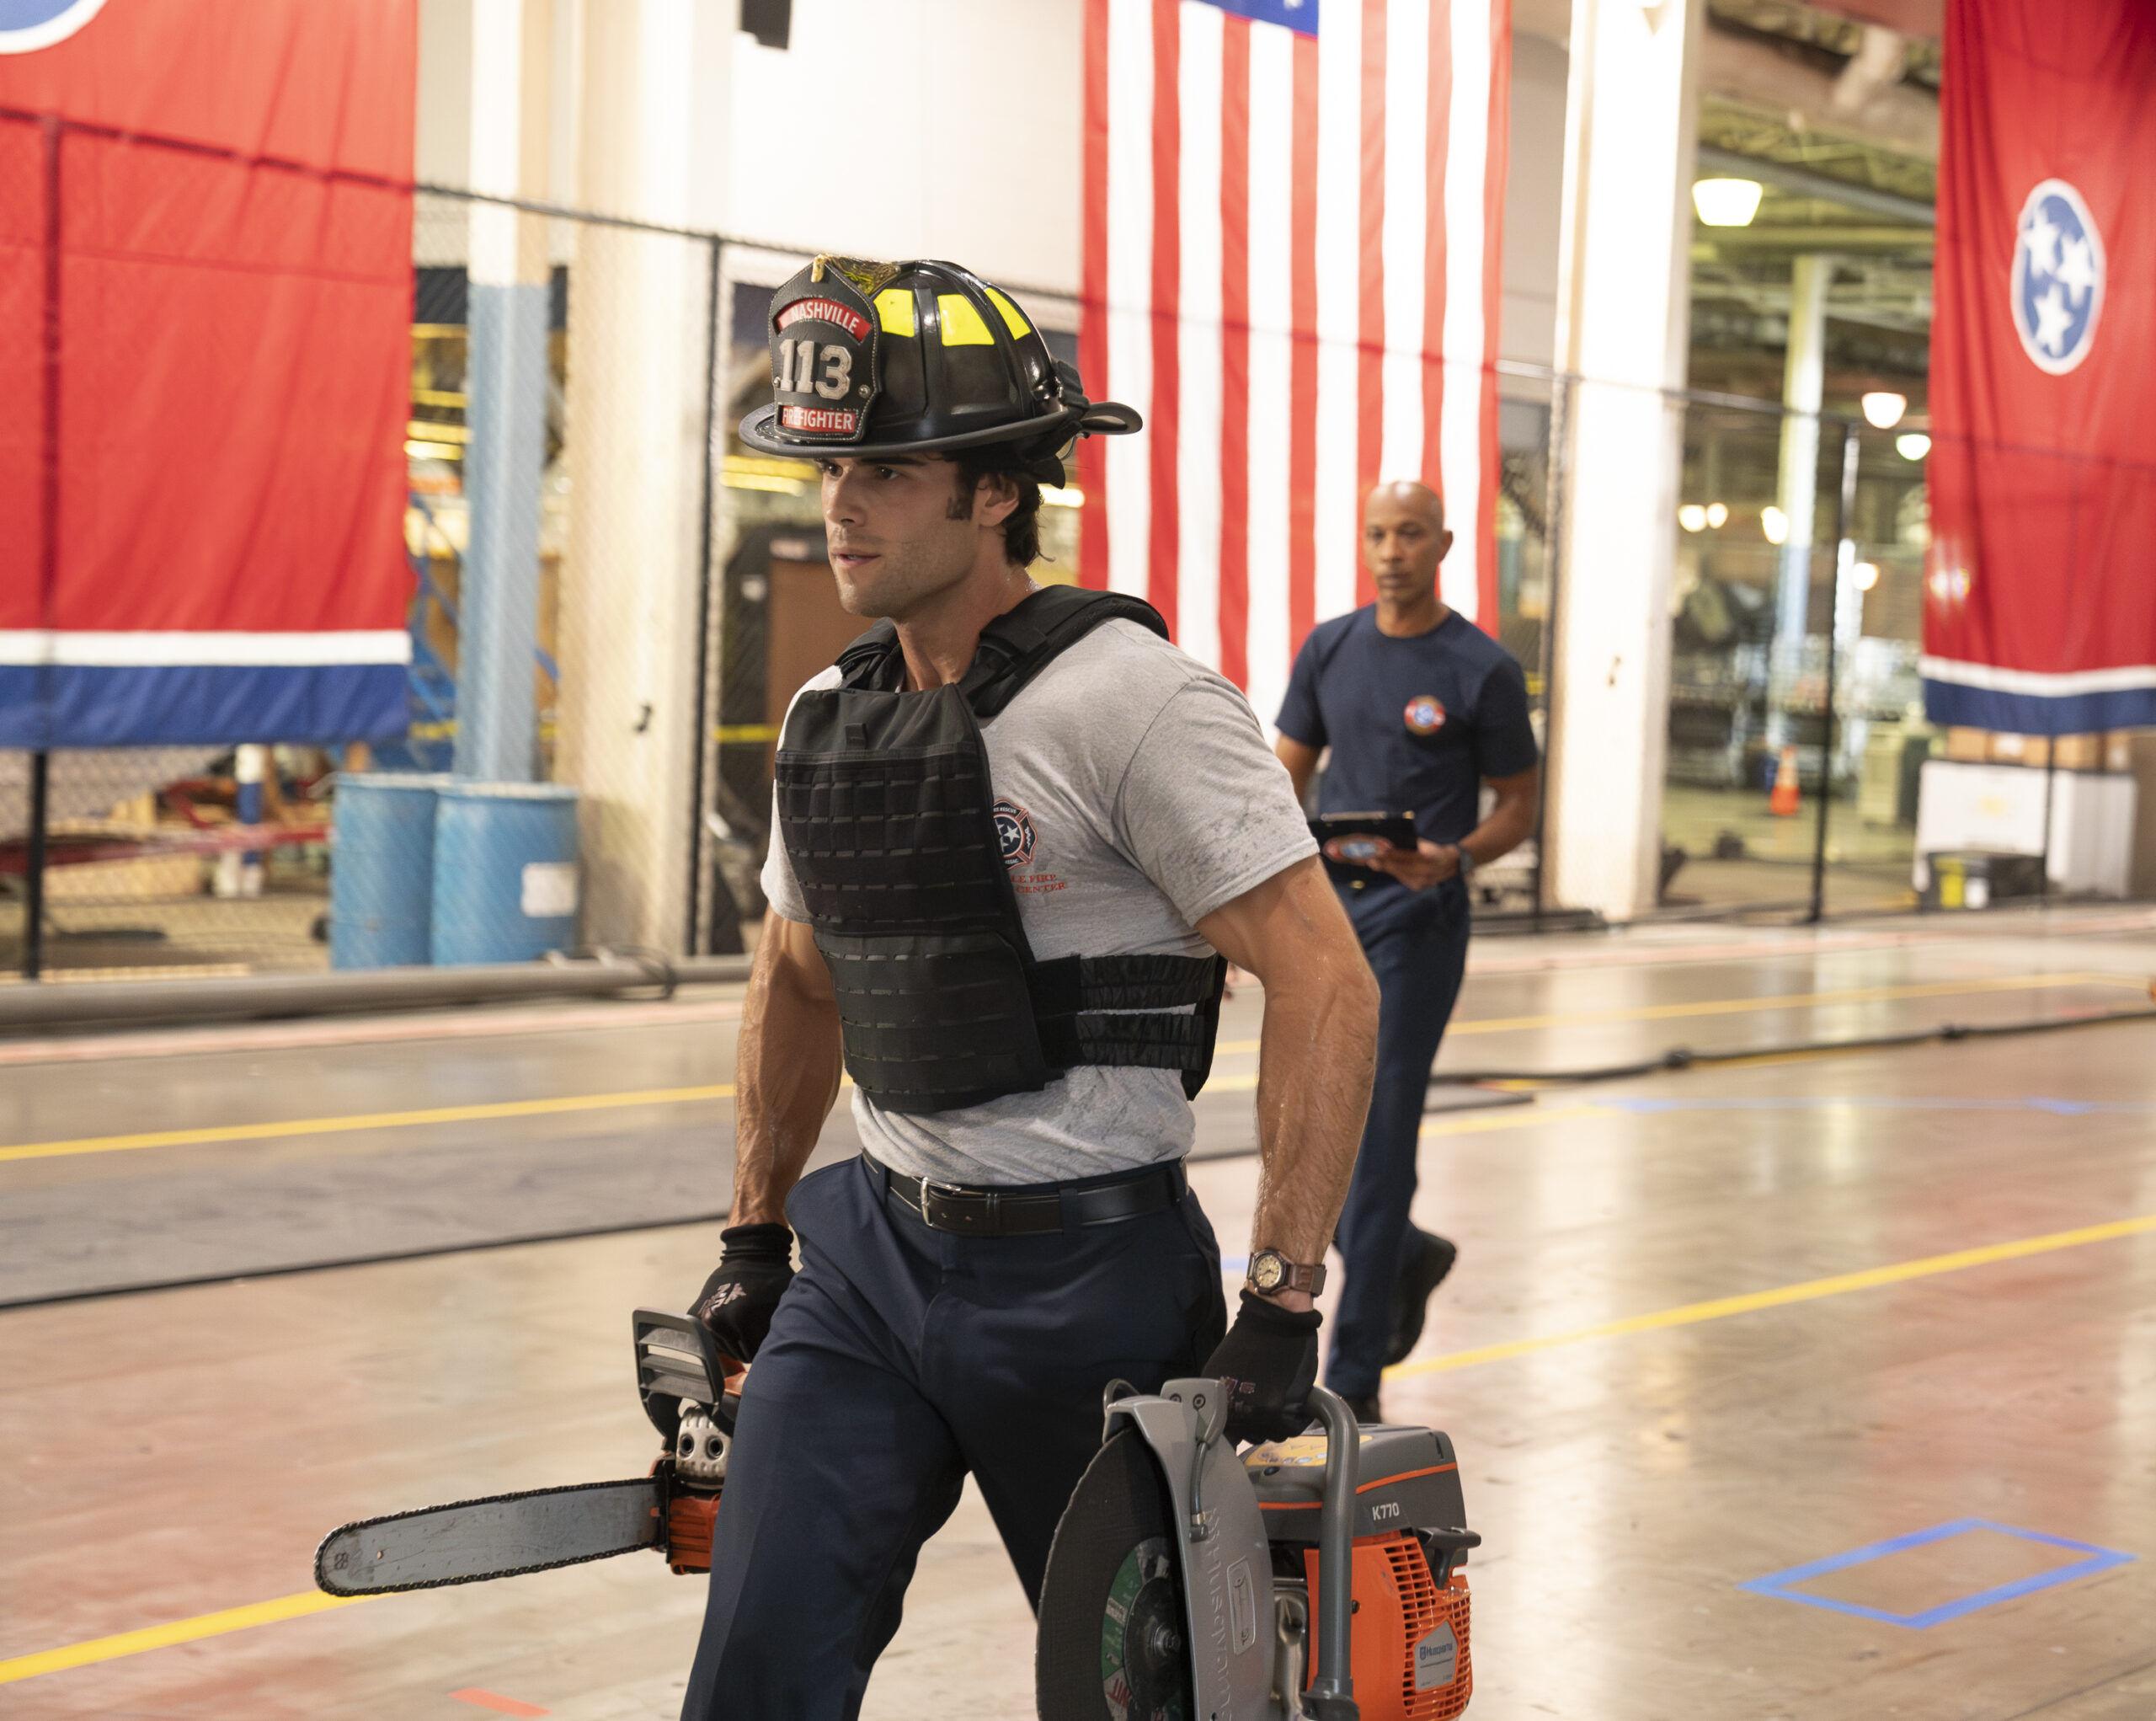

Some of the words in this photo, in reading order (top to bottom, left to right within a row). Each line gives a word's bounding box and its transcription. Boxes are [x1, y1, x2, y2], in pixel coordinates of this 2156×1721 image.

[791, 302, 860, 334] NASHVILLE
[779, 339, 852, 400] 113
[782, 408, 853, 430] FIREFIGHTER
[1017, 882, 1066, 894] CENTER
[1029, 874, 1058, 884] FIRE
[1372, 1502, 1401, 1521] K770
